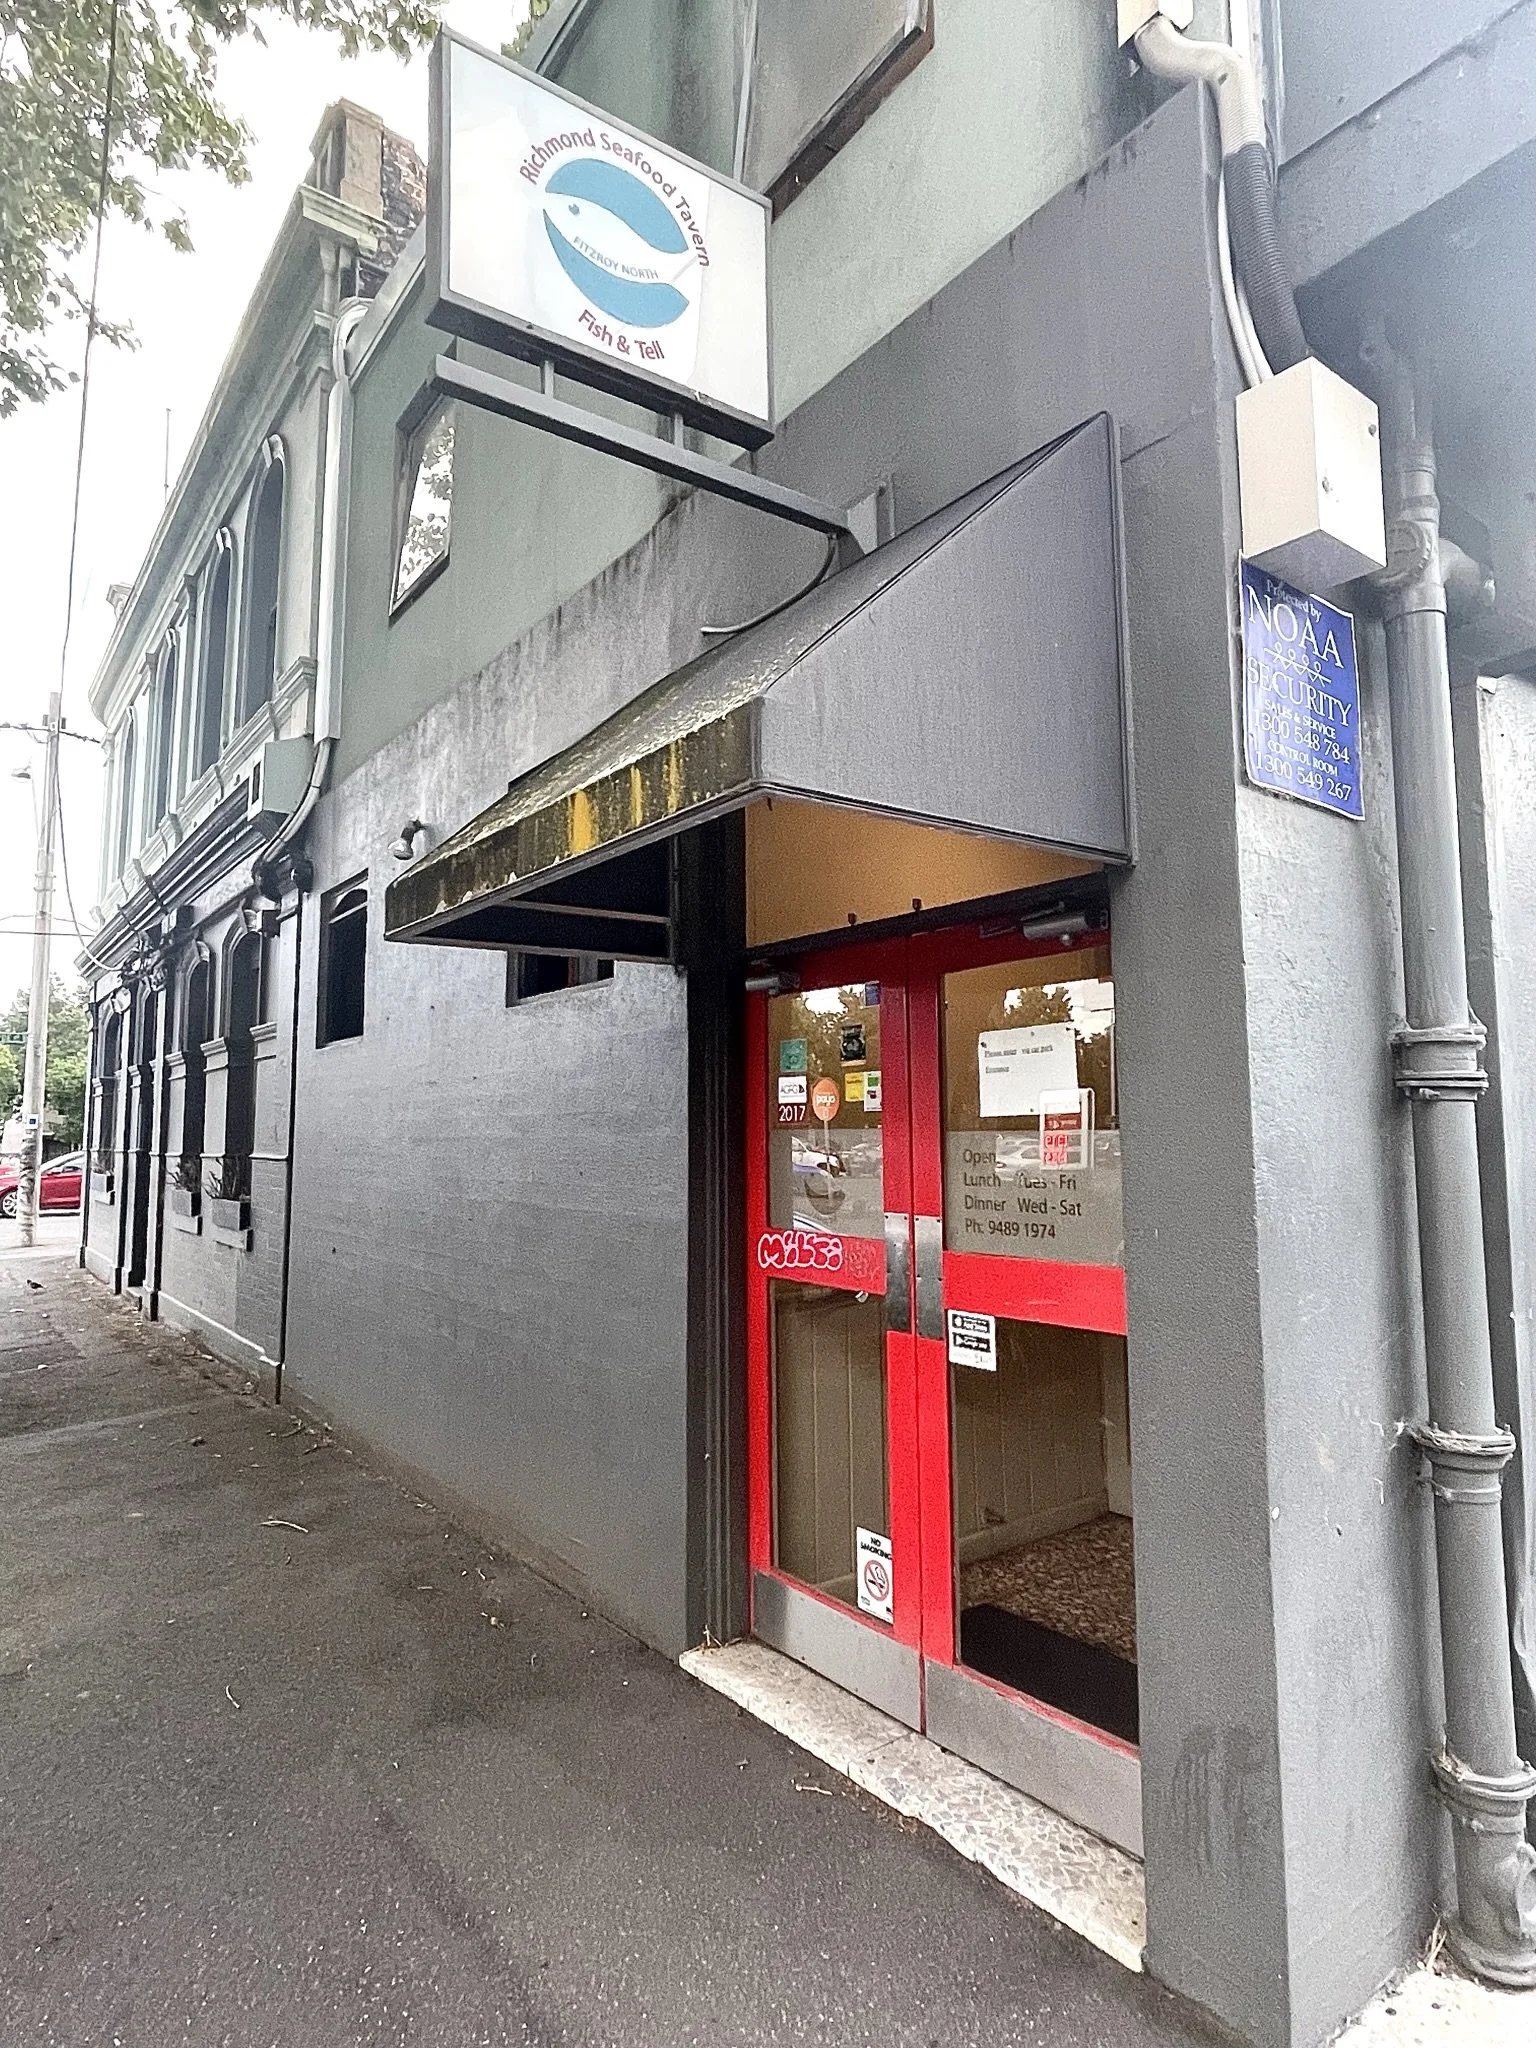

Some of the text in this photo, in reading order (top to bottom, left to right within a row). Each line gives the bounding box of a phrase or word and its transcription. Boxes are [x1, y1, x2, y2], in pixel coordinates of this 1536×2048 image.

[520, 128, 710, 267] Richmond Seafood Tavern
[573, 236, 659, 280] FITZROY NORTH
[578, 309, 665, 360] Fish & Tell
[1246, 584, 1344, 669] NOAA
[1309, 603, 1322, 623] by
[1247, 656, 1351, 727] SECURITY
[1254, 709, 1350, 765] 1300 548 784
[1264, 699, 1293, 720] SALES
[1302, 715, 1337, 740] SERVICE
[1255, 751, 1352, 801] 1300 549 267
[1267, 740, 1339, 777] CONTROL ROOM
[779, 1105, 806, 1122] 2017
[963, 1149, 997, 1166] Open
[963, 1173, 1002, 1188] Lunch
[1059, 1174, 1077, 1191] Fri
[964, 1195, 1007, 1212] Dinner
[1017, 1197, 1048, 1214] Wed
[1059, 1200, 1082, 1217] Sat
[988, 1220, 1020, 1237] 9489
[1025, 1223, 1056, 1239] 1974
[861, 1540, 893, 1560] SMOKING
[871, 1536, 882, 1547] NO
